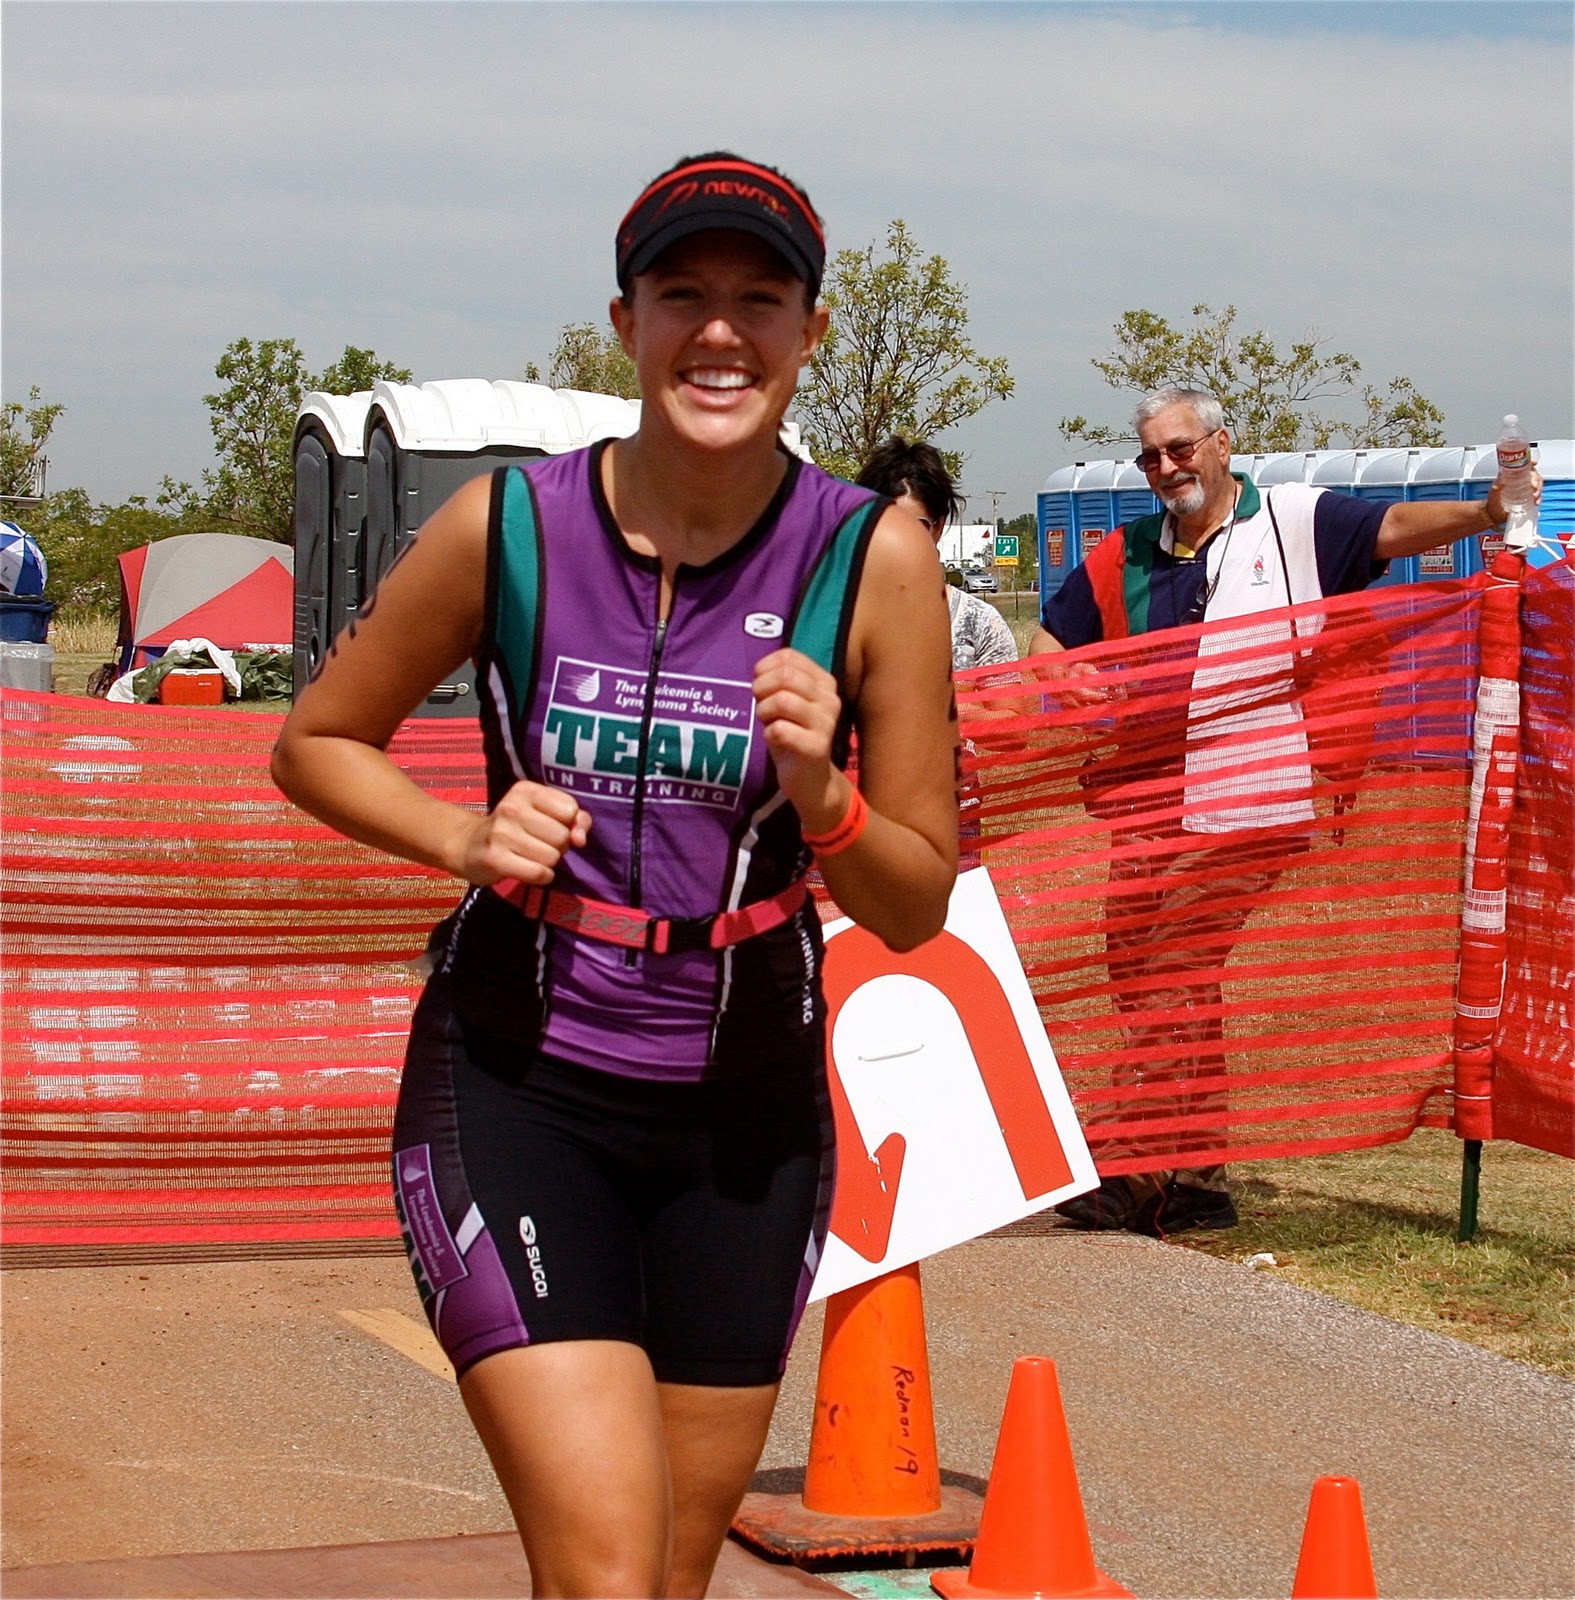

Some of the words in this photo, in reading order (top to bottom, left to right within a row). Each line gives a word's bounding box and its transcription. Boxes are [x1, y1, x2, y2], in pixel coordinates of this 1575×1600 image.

[615, 679, 638, 694] The
[640, 682, 701, 701] Lukemia
[703, 689, 713, 701] &
[615, 693, 688, 712] Lymoma
[691, 697, 739, 719] Society
[546, 708, 749, 788] TEAM
[549, 771, 575, 787] IN
[526, 1245, 549, 1298] SUGOI
